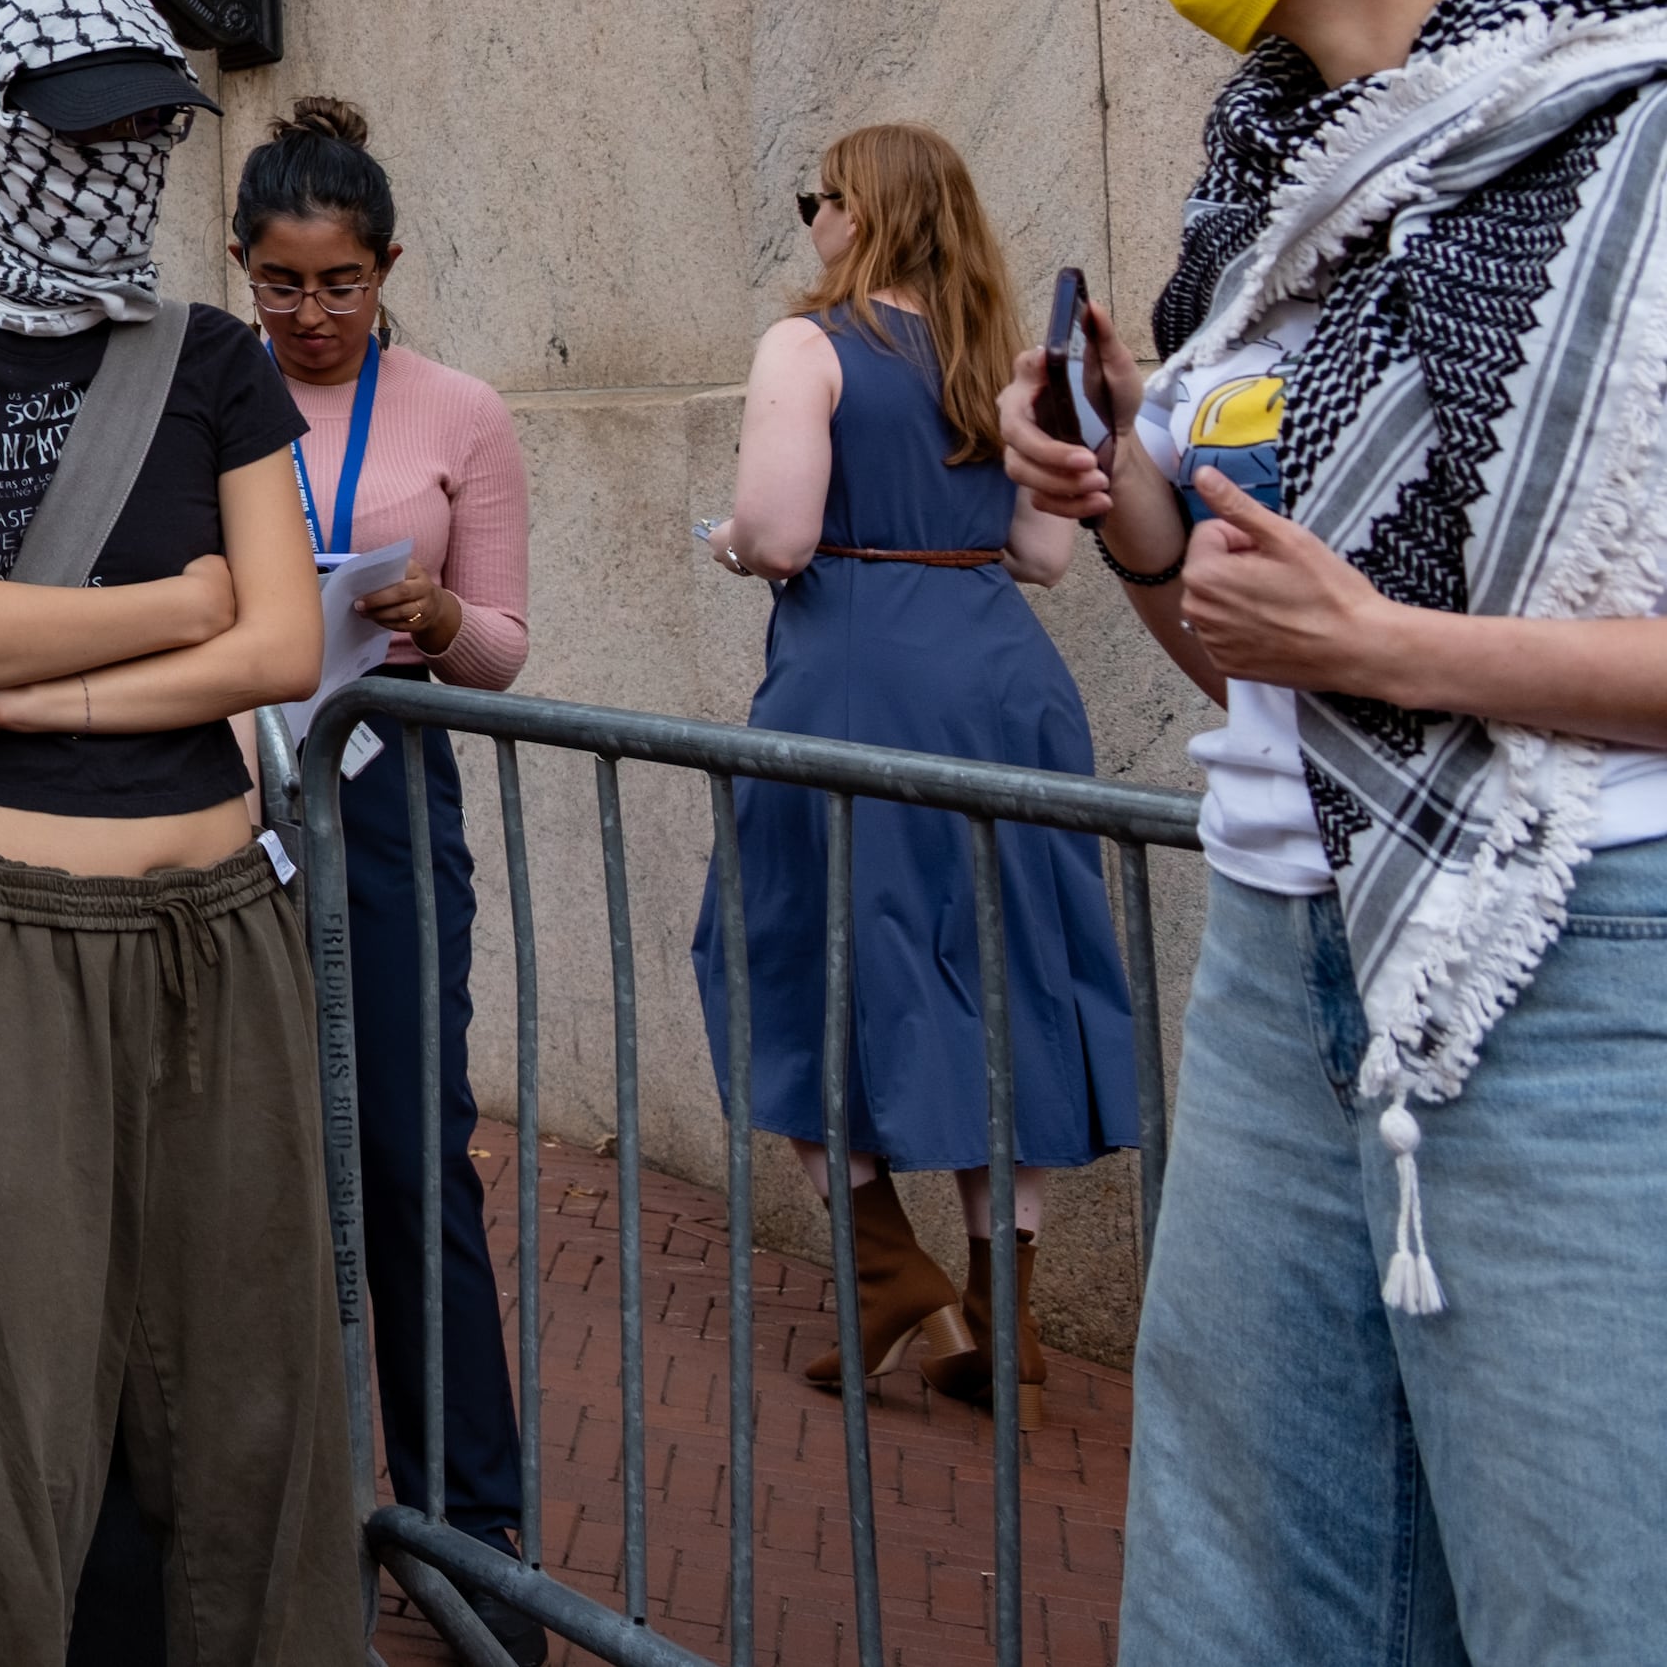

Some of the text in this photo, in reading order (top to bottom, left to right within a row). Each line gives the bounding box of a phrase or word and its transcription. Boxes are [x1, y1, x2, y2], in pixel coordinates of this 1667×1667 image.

[5, 387, 87, 427] SOLID
[38, 472, 54, 483] LO
[305, 518, 320, 553] STUDENT
[322, 912, 351, 1081] FRIEDRICHS
